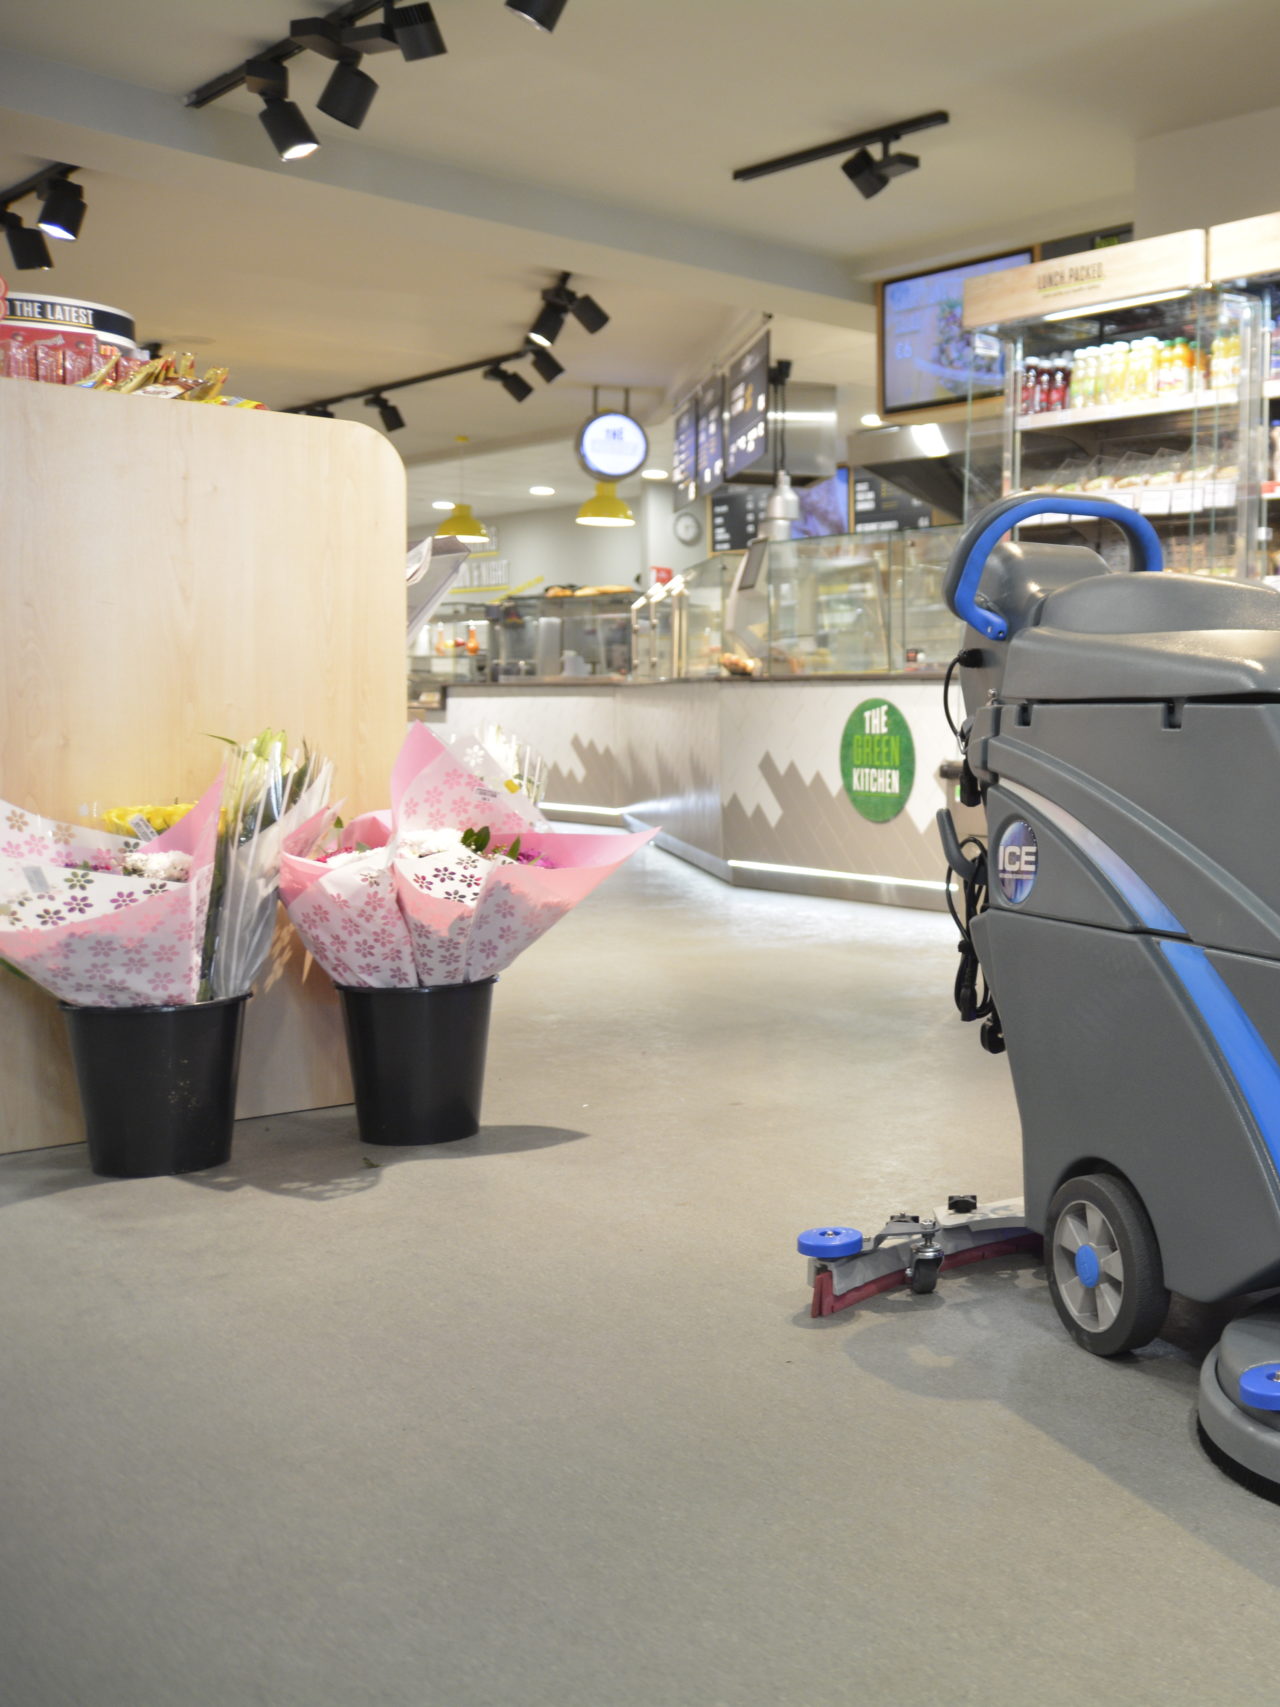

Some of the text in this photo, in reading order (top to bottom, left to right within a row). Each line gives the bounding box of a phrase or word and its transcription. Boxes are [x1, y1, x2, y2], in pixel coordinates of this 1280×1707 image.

[14, 300, 95, 325] THE LATEST
[863, 704, 889, 734] THE
[852, 735, 900, 766] GREEN
[852, 767, 900, 794] KITCHEN
[998, 845, 1037, 871] ICE
